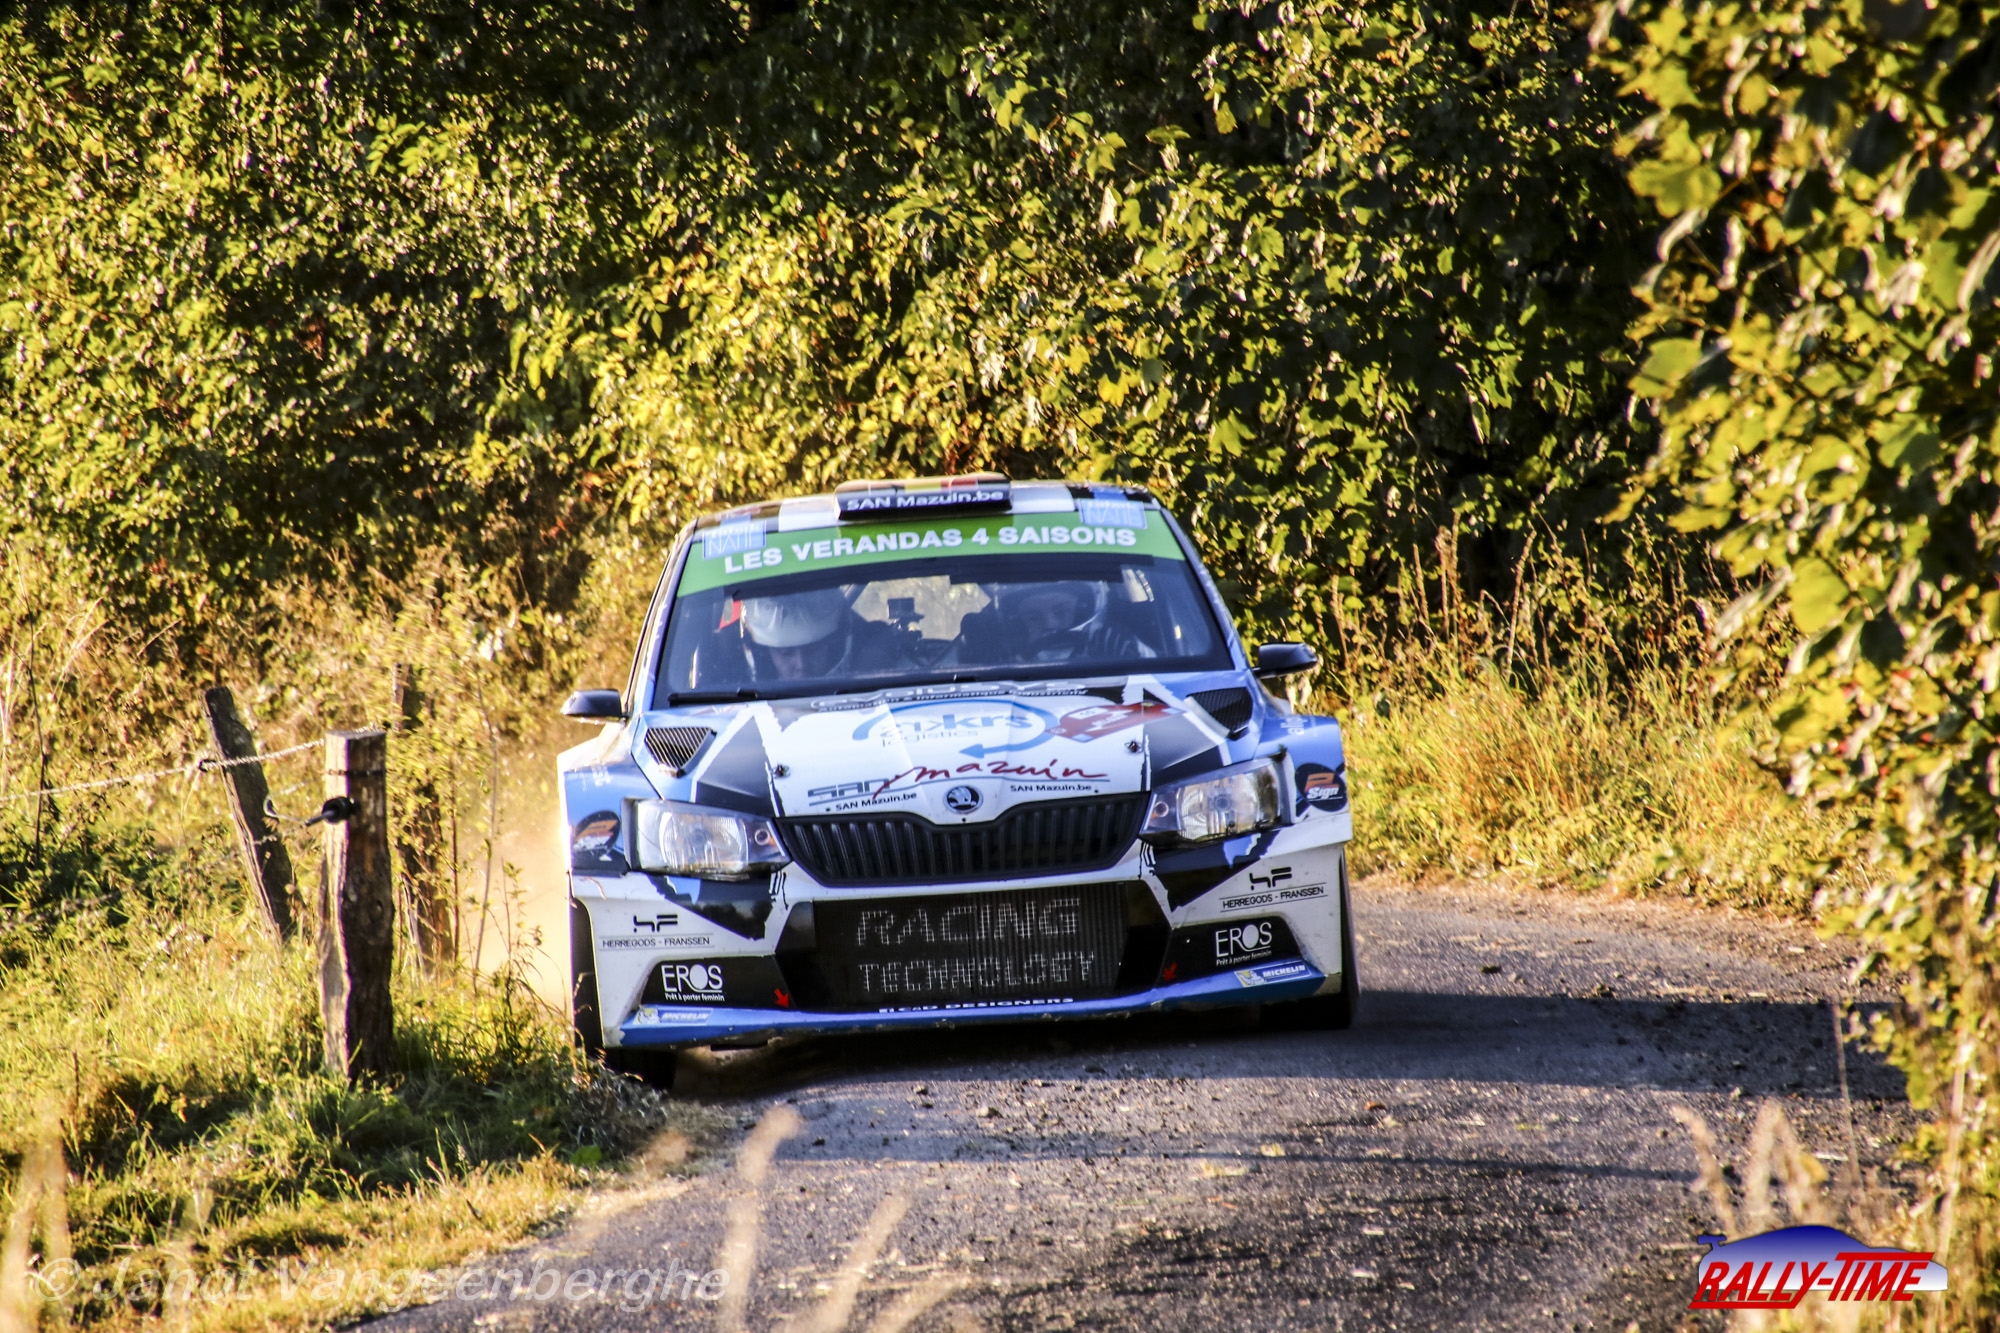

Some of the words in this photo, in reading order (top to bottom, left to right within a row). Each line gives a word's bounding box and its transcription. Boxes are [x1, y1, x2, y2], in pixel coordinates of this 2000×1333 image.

[847, 497, 891, 511] SAN
[897, 490, 1004, 507] Mazuin.be
[724, 547, 783, 574] LES
[791, 529, 962, 561] VERANDAS
[972, 528, 989, 545] 4
[998, 526, 1137, 547] SAISONS
[1036, 784, 1092, 792] Mazuin.be
[836, 801, 858, 811] SAN
[861, 792, 917, 807] Mazuin.be
[1223, 894, 1273, 909] HERREGODS
[1280, 886, 1324, 900] FRANSSEN
[856, 898, 1080, 946] RACING
[602, 938, 656, 948] HERREGODS
[664, 937, 710, 946] FRANSSEN
[1215, 922, 1272, 957] EROS
[1234, 954, 1251, 963] porter
[661, 964, 724, 993] EROS
[858, 951, 1095, 992] TECHNOLOGY
[1262, 965, 1306, 978] MICHELIN
[683, 993, 700, 1002] porter
[661, 1012, 709, 1020] MICHELIN
